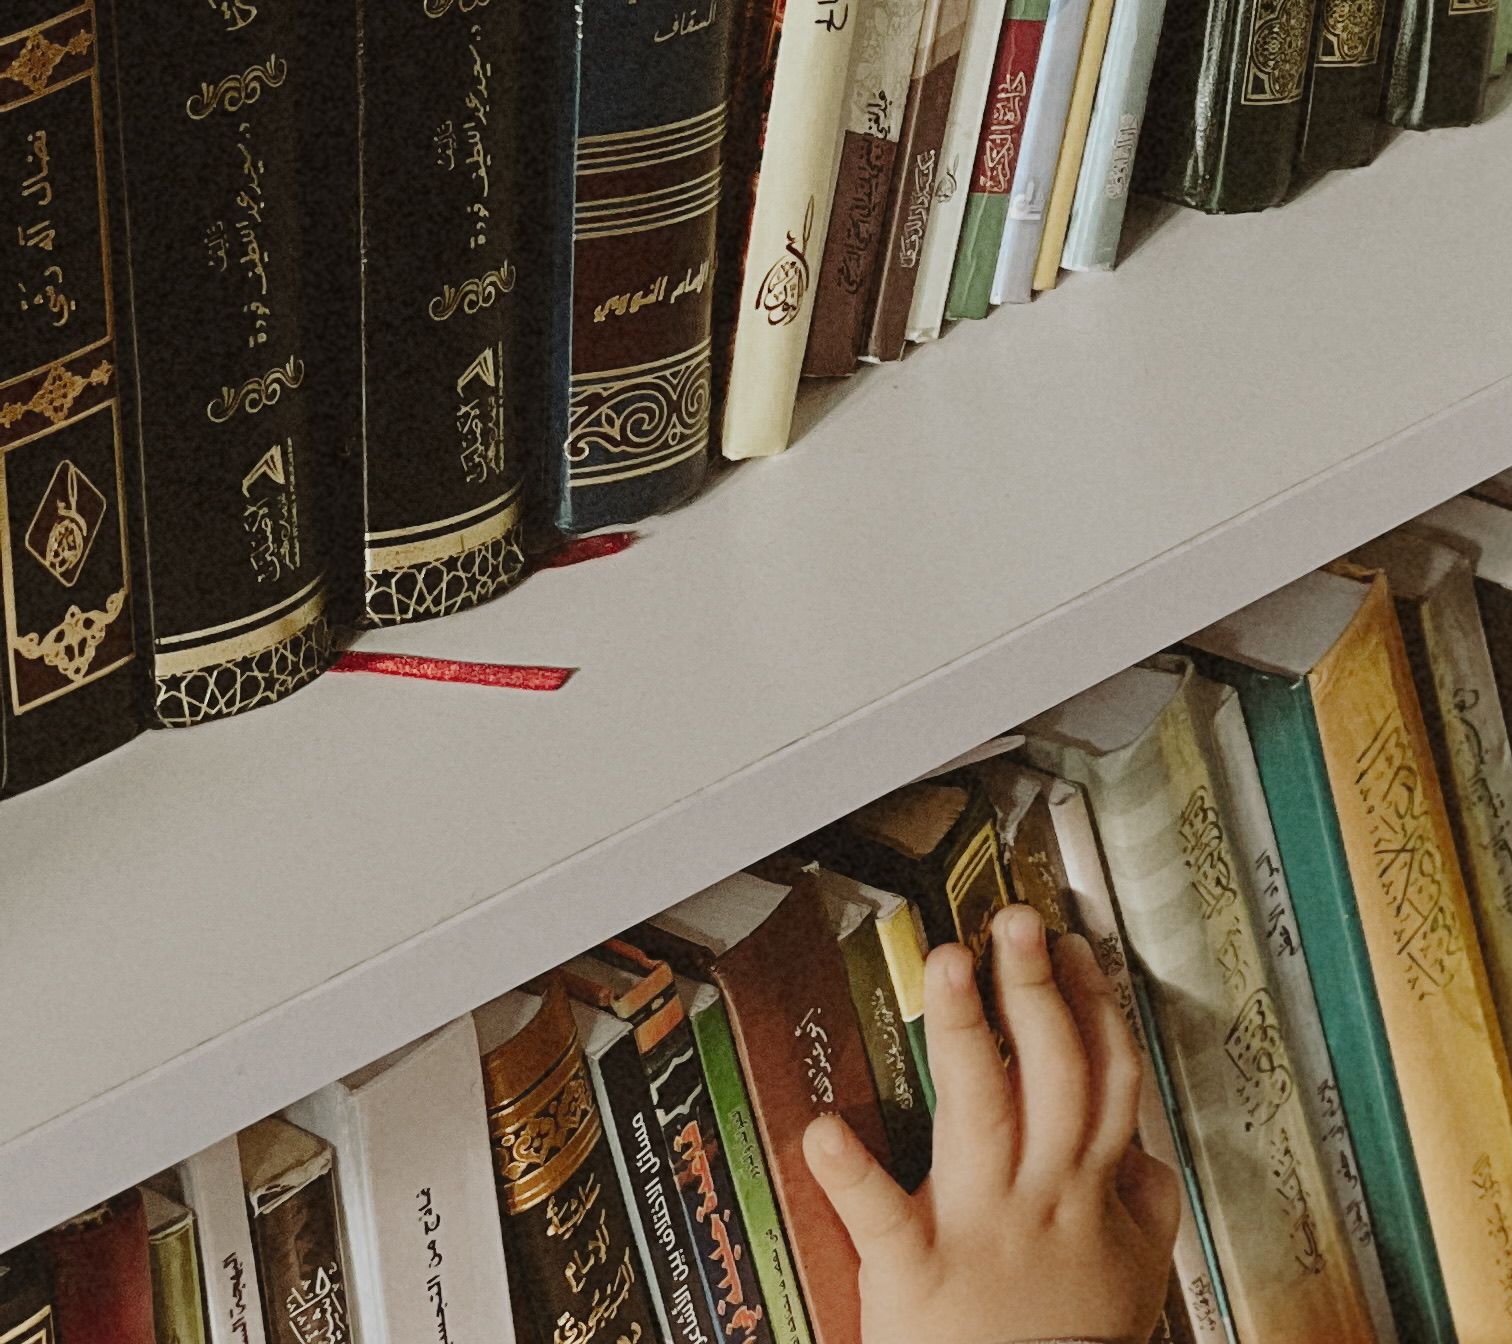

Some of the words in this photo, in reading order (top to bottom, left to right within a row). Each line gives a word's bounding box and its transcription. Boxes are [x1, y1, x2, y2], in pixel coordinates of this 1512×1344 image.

[653, 0, 718, 44] السقاف
[18, 130, 53, 205] نضال
[593, 275, 668, 324] النووي
[630, 1110, 662, 1172] مسائل
[415, 1186, 442, 1236] نماذج
[643, 1176, 677, 1250] الاختلاف
[425, 1239, 444, 1269] من
[664, 1248, 690, 1281] بين
[221, 1250, 247, 1316] البهجة
